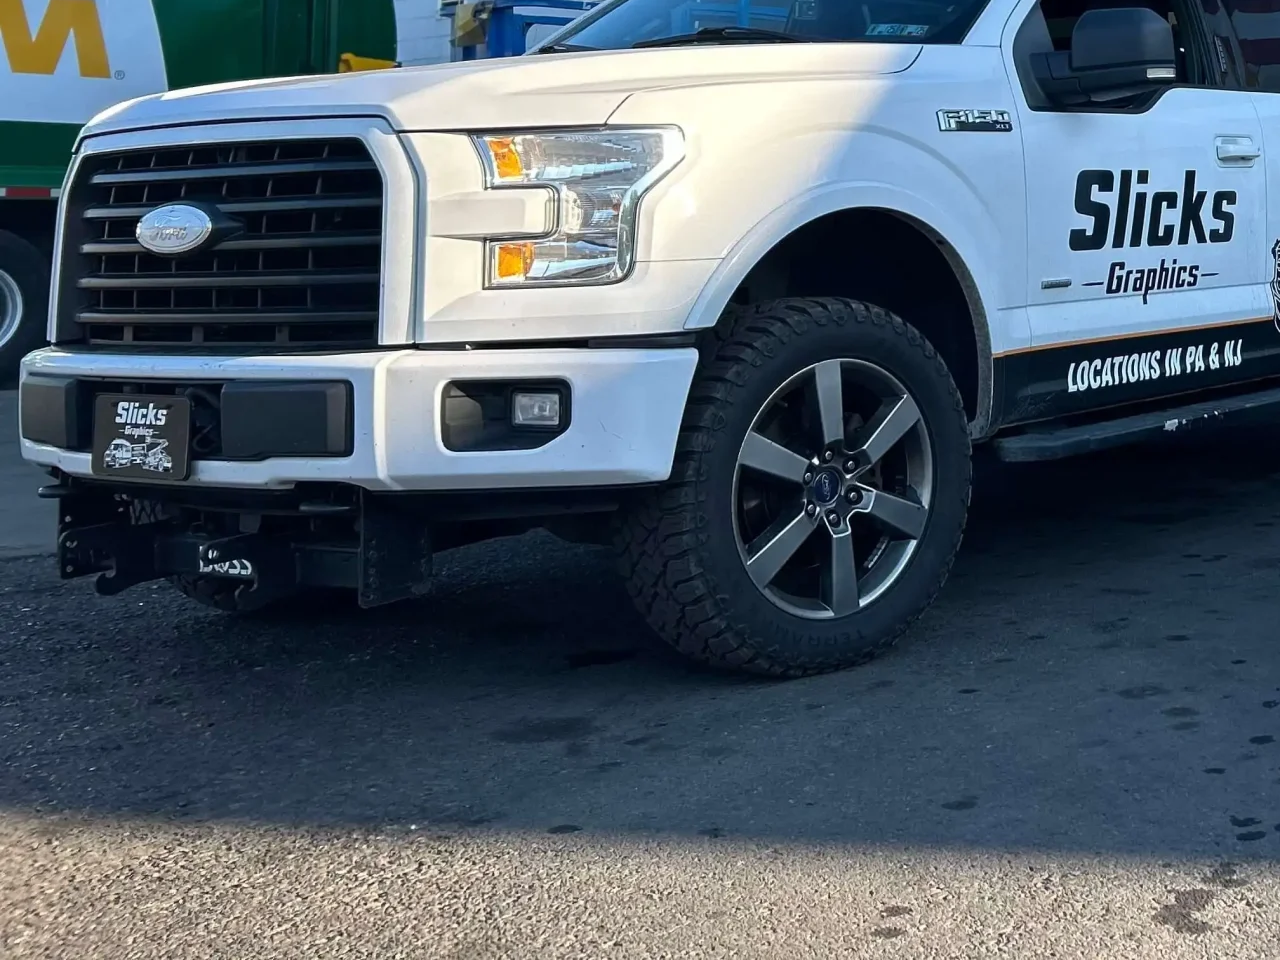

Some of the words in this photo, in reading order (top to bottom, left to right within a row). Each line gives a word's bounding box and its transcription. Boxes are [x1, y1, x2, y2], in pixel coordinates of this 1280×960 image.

[1068, 169, 1237, 252] Slicks
[1106, 258, 1200, 304] Graphics
[1067, 350, 1160, 392] LOCATIONS
[1164, 348, 1182, 377] IN
[1186, 344, 1205, 374] PA
[1208, 342, 1220, 370] &
[1224, 338, 1242, 368] NJ
[115, 402, 168, 426] Slicks
[124, 426, 154, 439] Graphics
